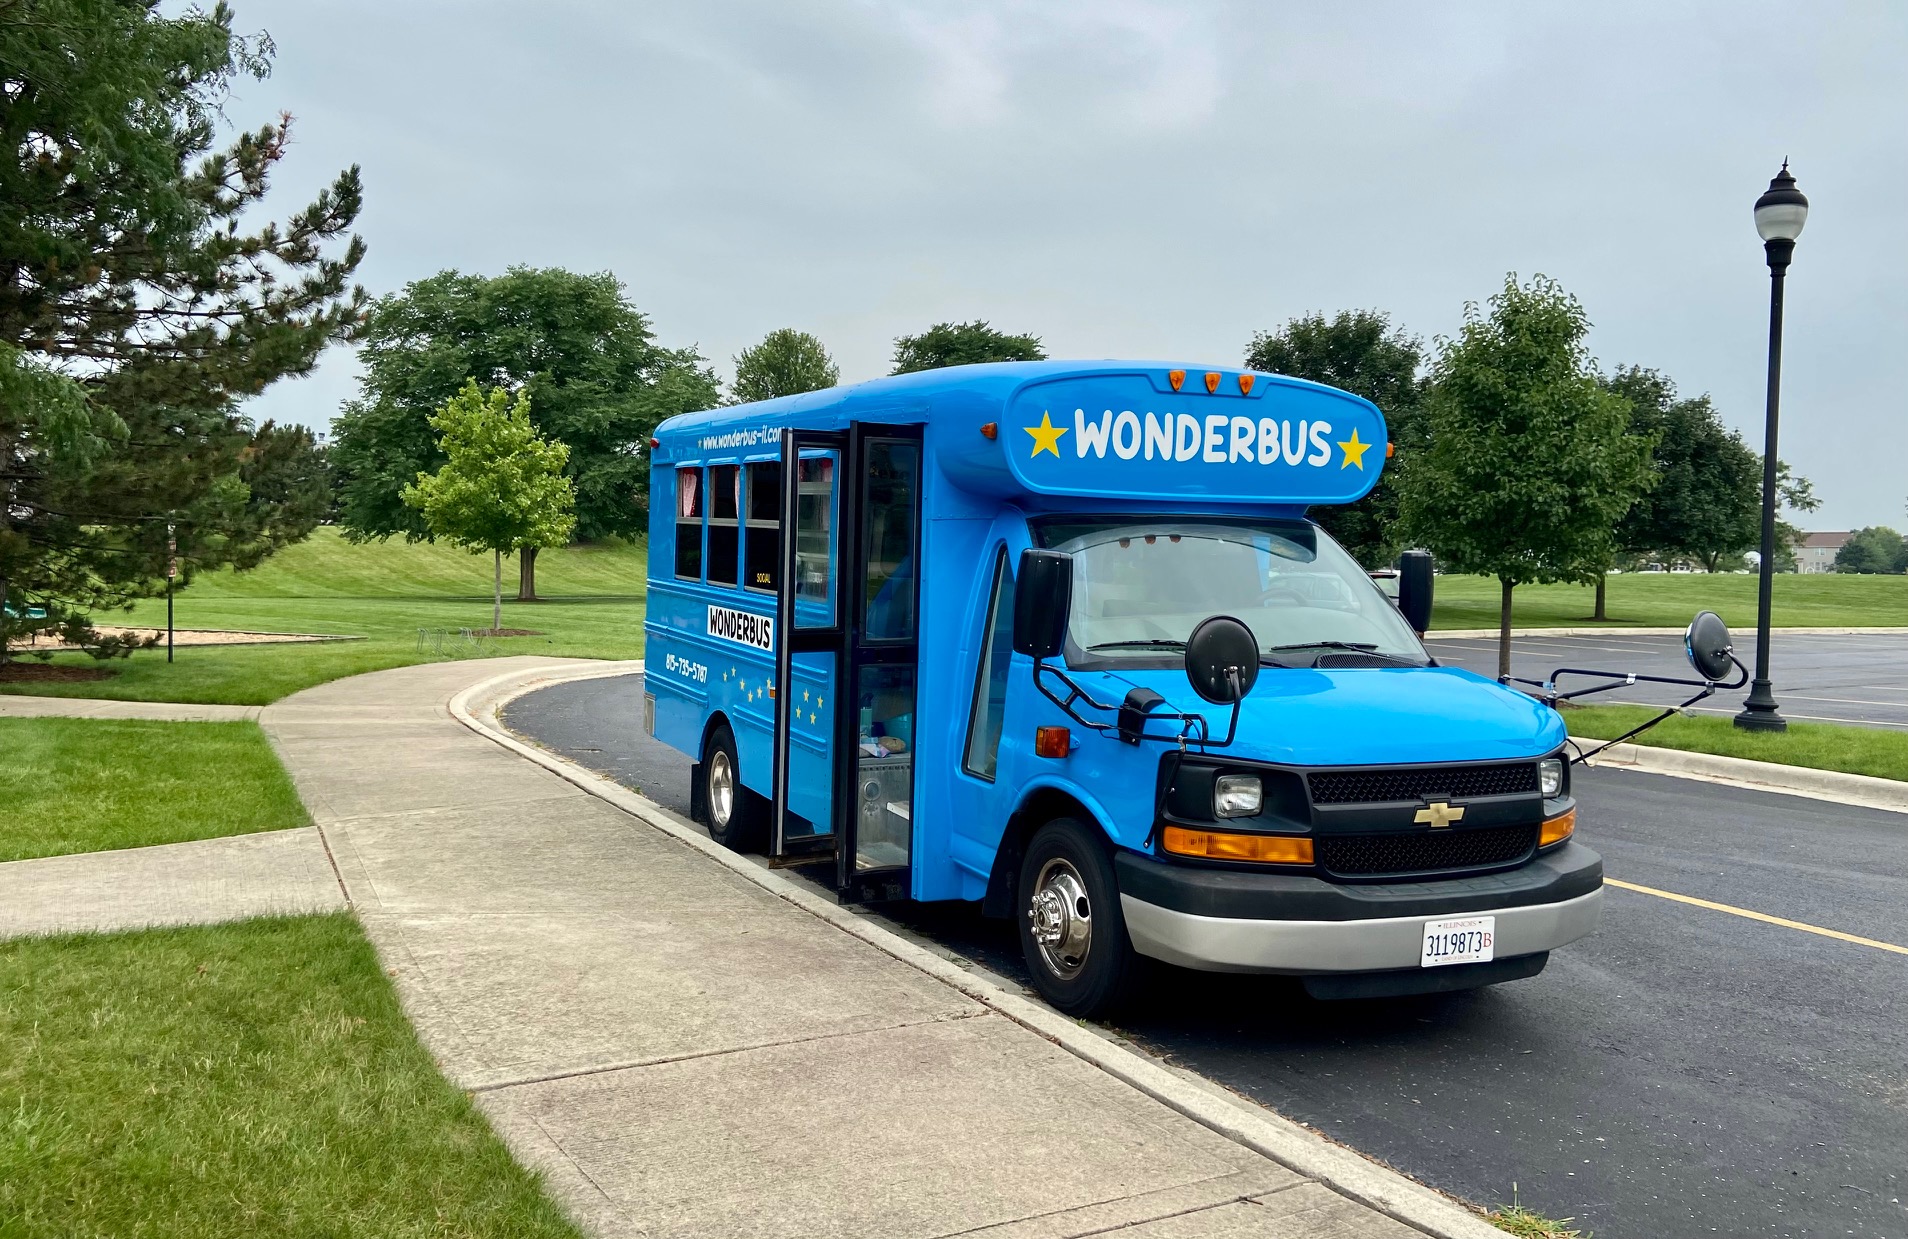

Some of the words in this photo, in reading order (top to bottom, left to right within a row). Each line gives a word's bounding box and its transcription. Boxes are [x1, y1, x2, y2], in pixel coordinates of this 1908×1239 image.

[1074, 408, 1332, 467] WONDERBUS
[709, 606, 770, 649] WONDERBUS
[665, 653, 708, 684] 815-735-5787
[1443, 920, 1477, 929] ILLINOIS
[1426, 931, 1482, 956] 3119873
